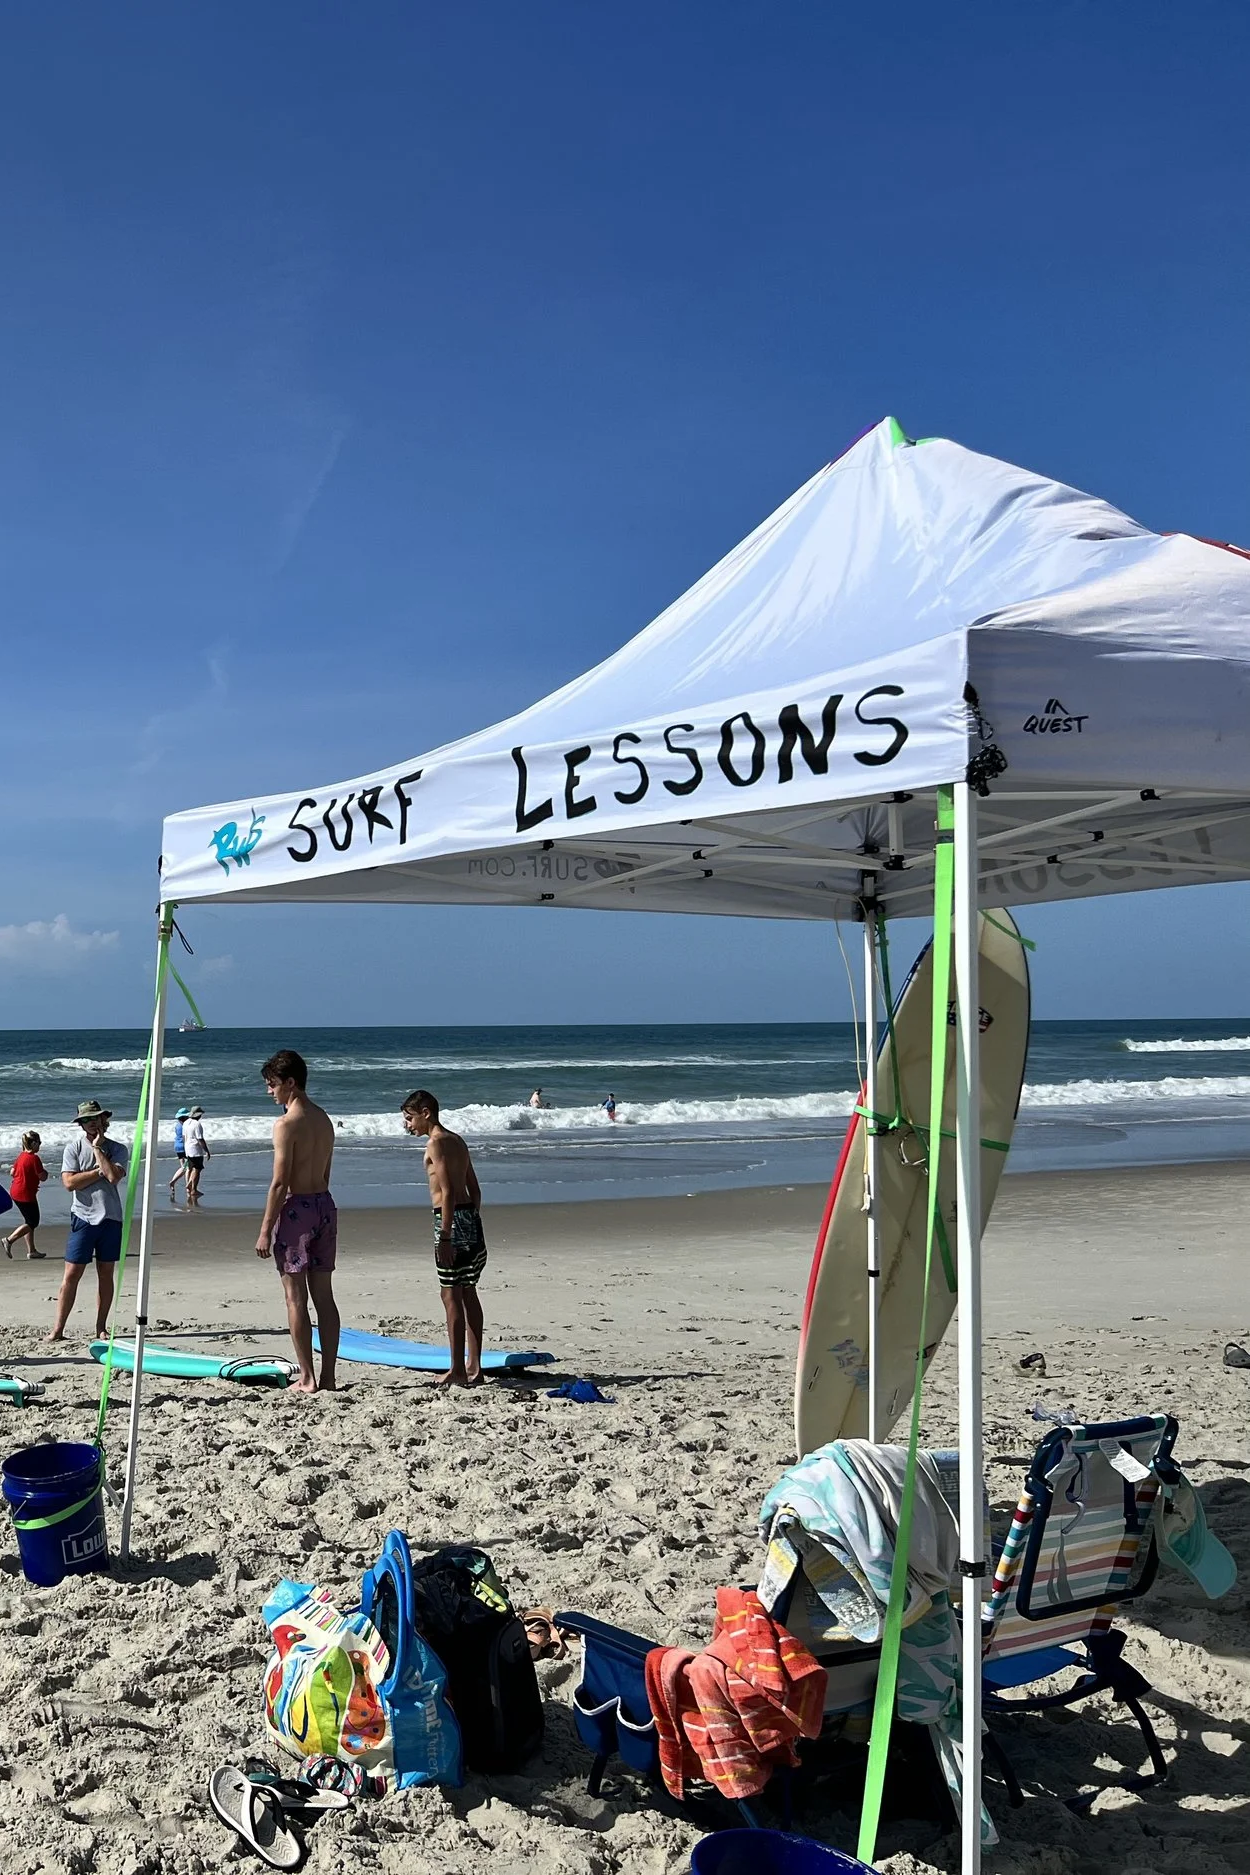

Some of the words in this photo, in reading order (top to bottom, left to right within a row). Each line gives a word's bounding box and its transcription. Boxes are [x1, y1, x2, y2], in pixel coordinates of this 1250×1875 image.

[1023, 714, 1089, 734] QUEST
[287, 769, 424, 863] SURF
[511, 684, 909, 833] LESSONS
[71, 1529, 106, 1558] LOW
